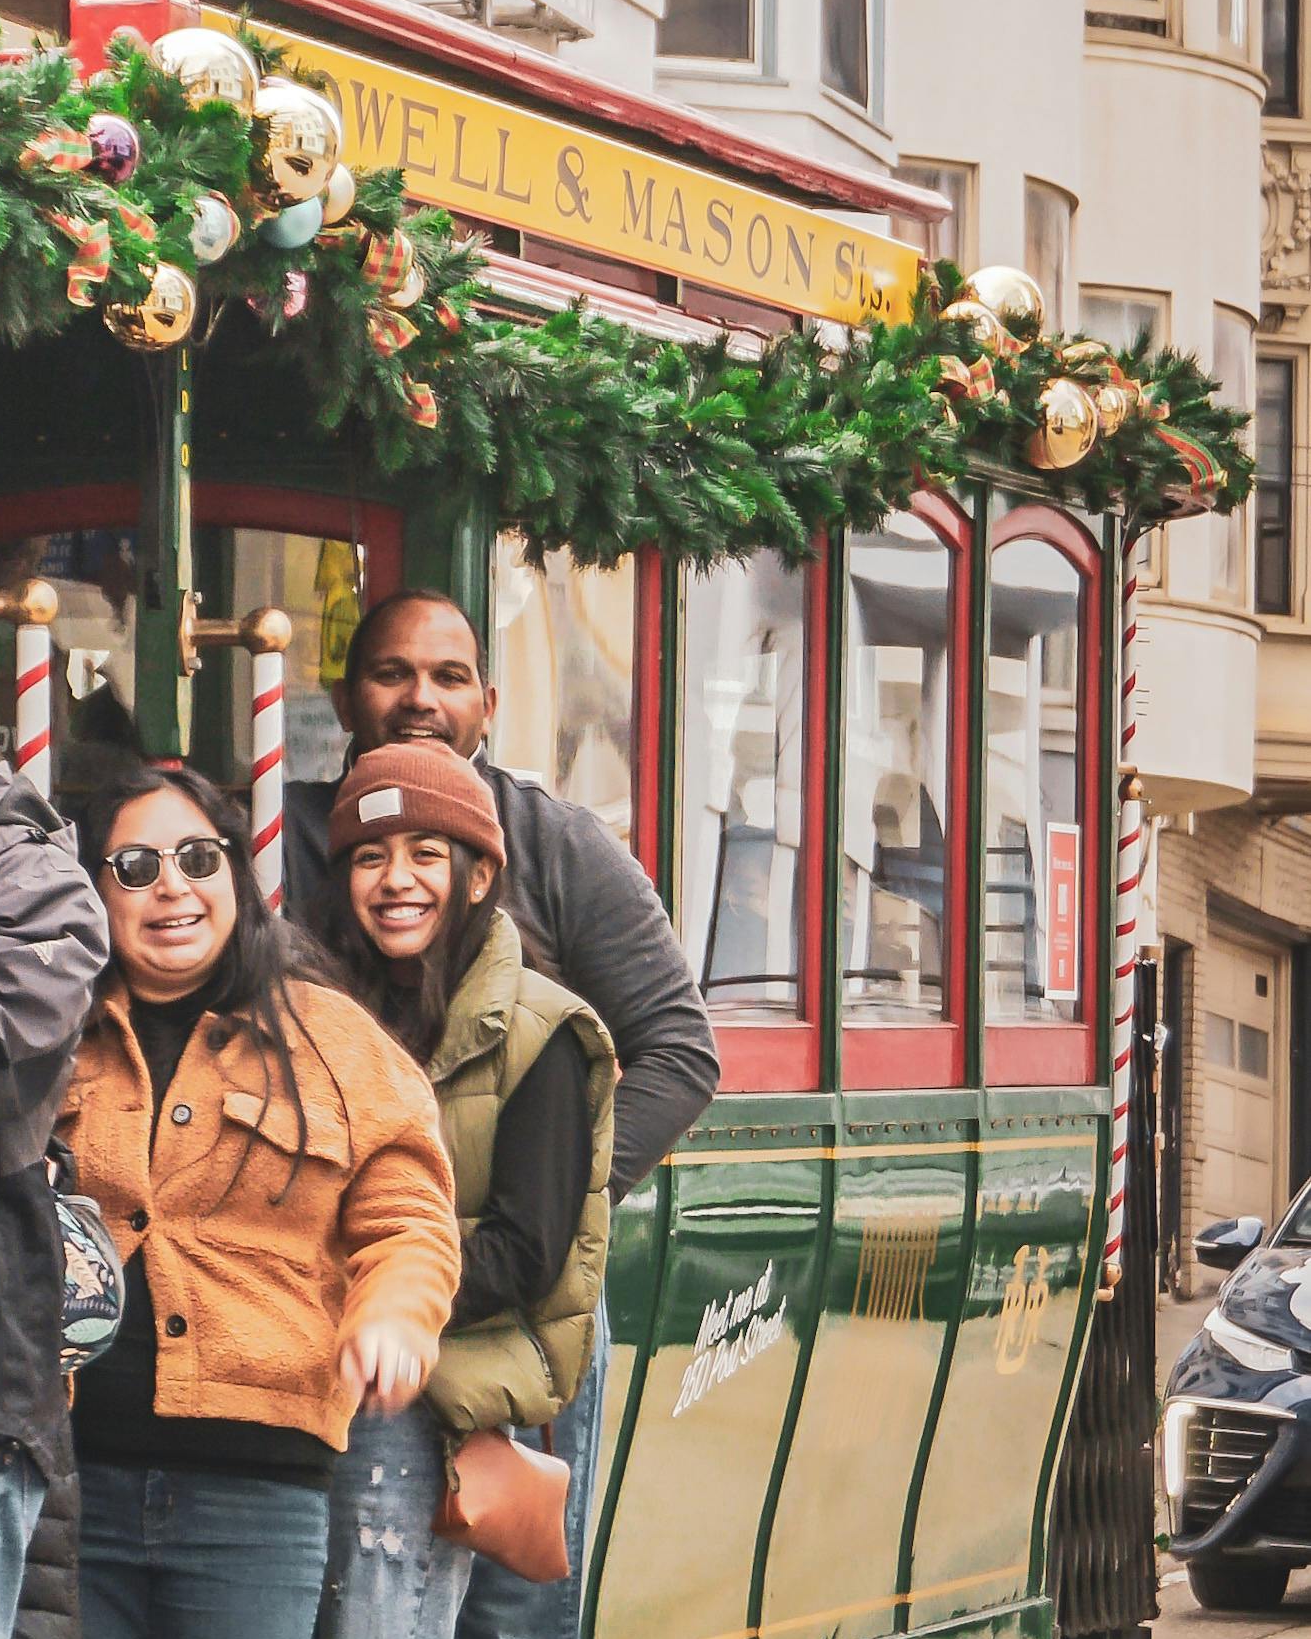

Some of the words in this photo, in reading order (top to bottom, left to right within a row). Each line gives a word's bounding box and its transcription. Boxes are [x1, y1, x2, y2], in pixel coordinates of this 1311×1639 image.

[322, 68, 531, 206] WELL
[557, 145, 593, 222] &
[620, 169, 817, 292] MASON
